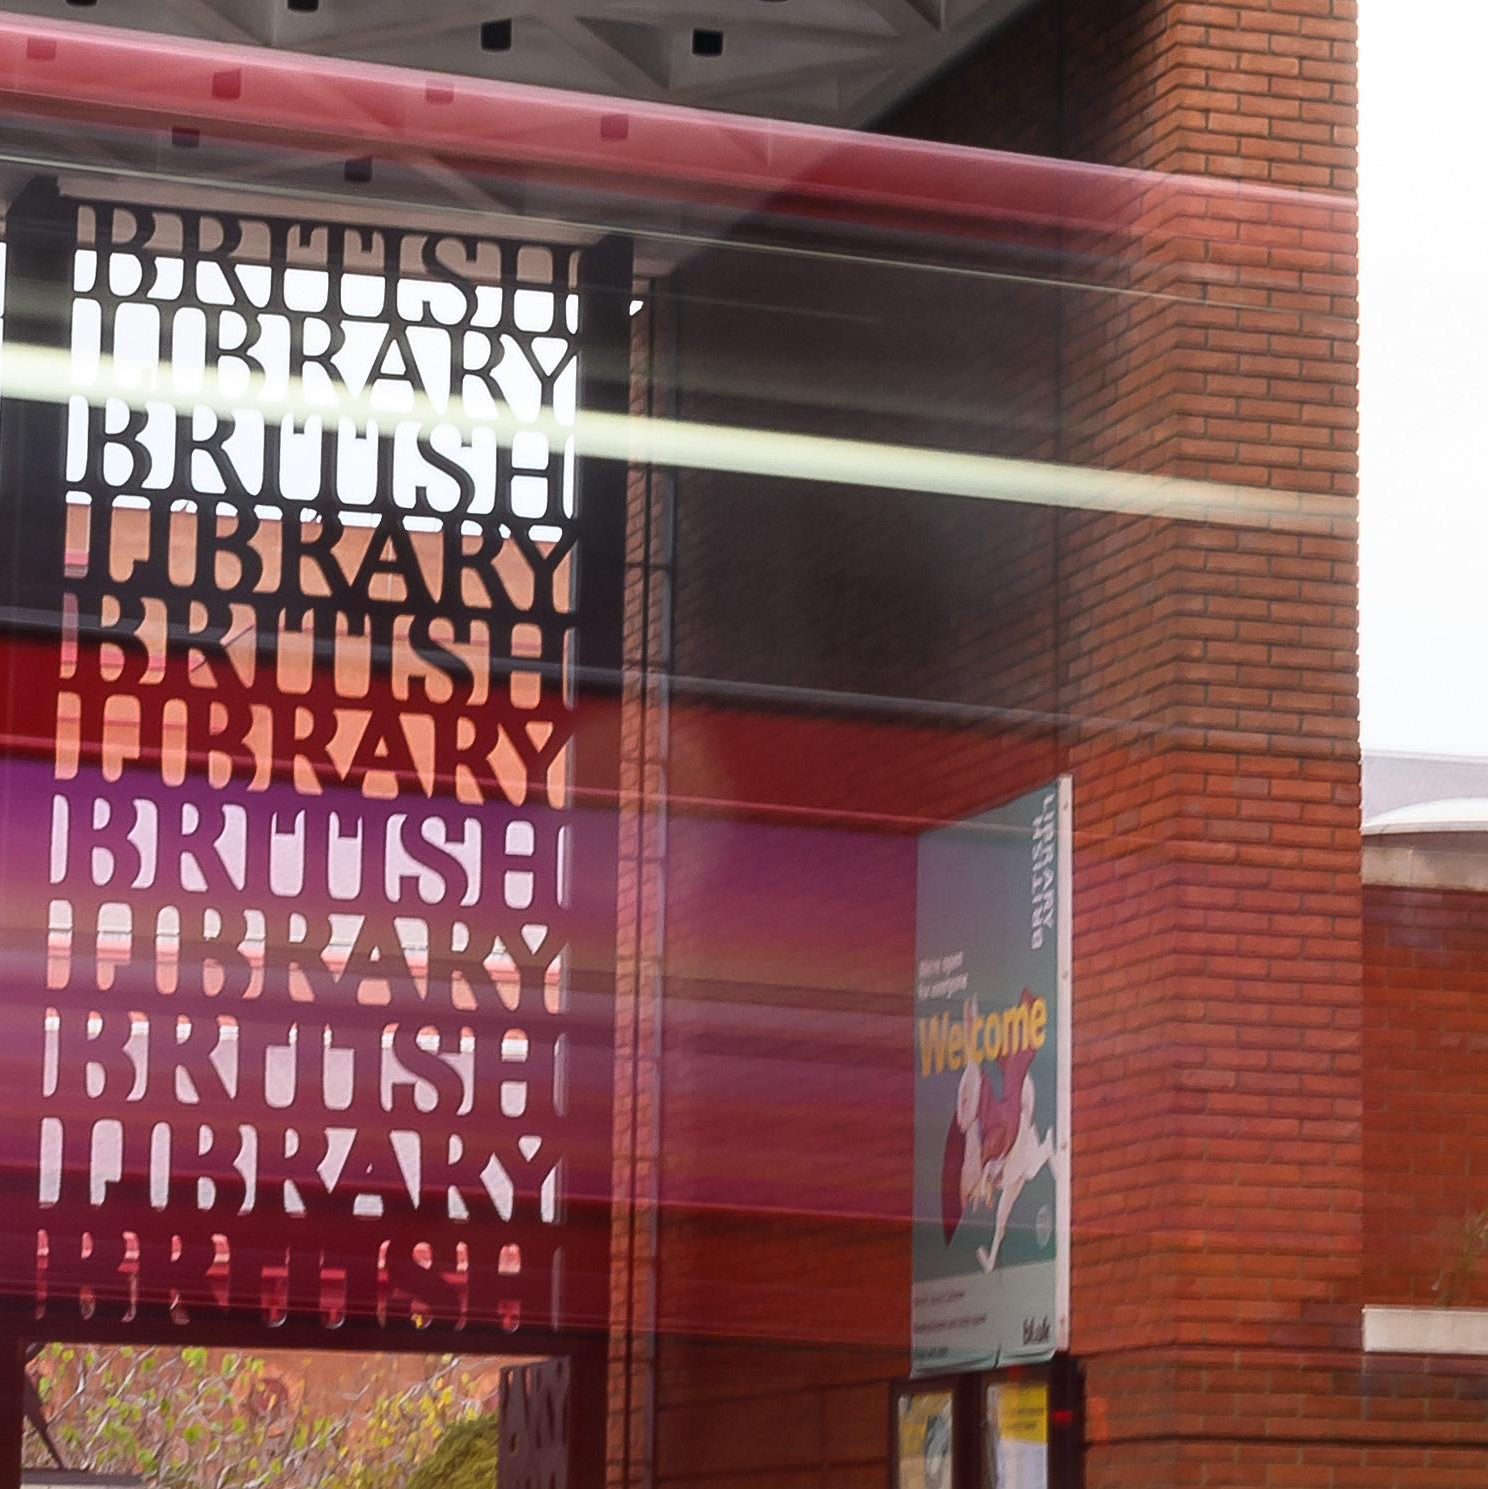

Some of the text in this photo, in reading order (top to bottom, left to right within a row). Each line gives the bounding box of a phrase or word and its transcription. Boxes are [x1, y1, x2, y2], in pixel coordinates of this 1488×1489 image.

[89, 203, 572, 335] BRITISH
[94, 299, 578, 426] LIBRARY
[83, 396, 569, 520] BRITISH
[84, 492, 579, 613] LIBRARY
[73, 594, 568, 711] BRITISH
[74, 692, 575, 810] LIBRARY
[63, 794, 562, 910] BRITISH
[64, 899, 572, 1015] LIBRARY
[55, 1007, 558, 1117] BRITISH
[55, 1117, 565, 1226] LIBRARY
